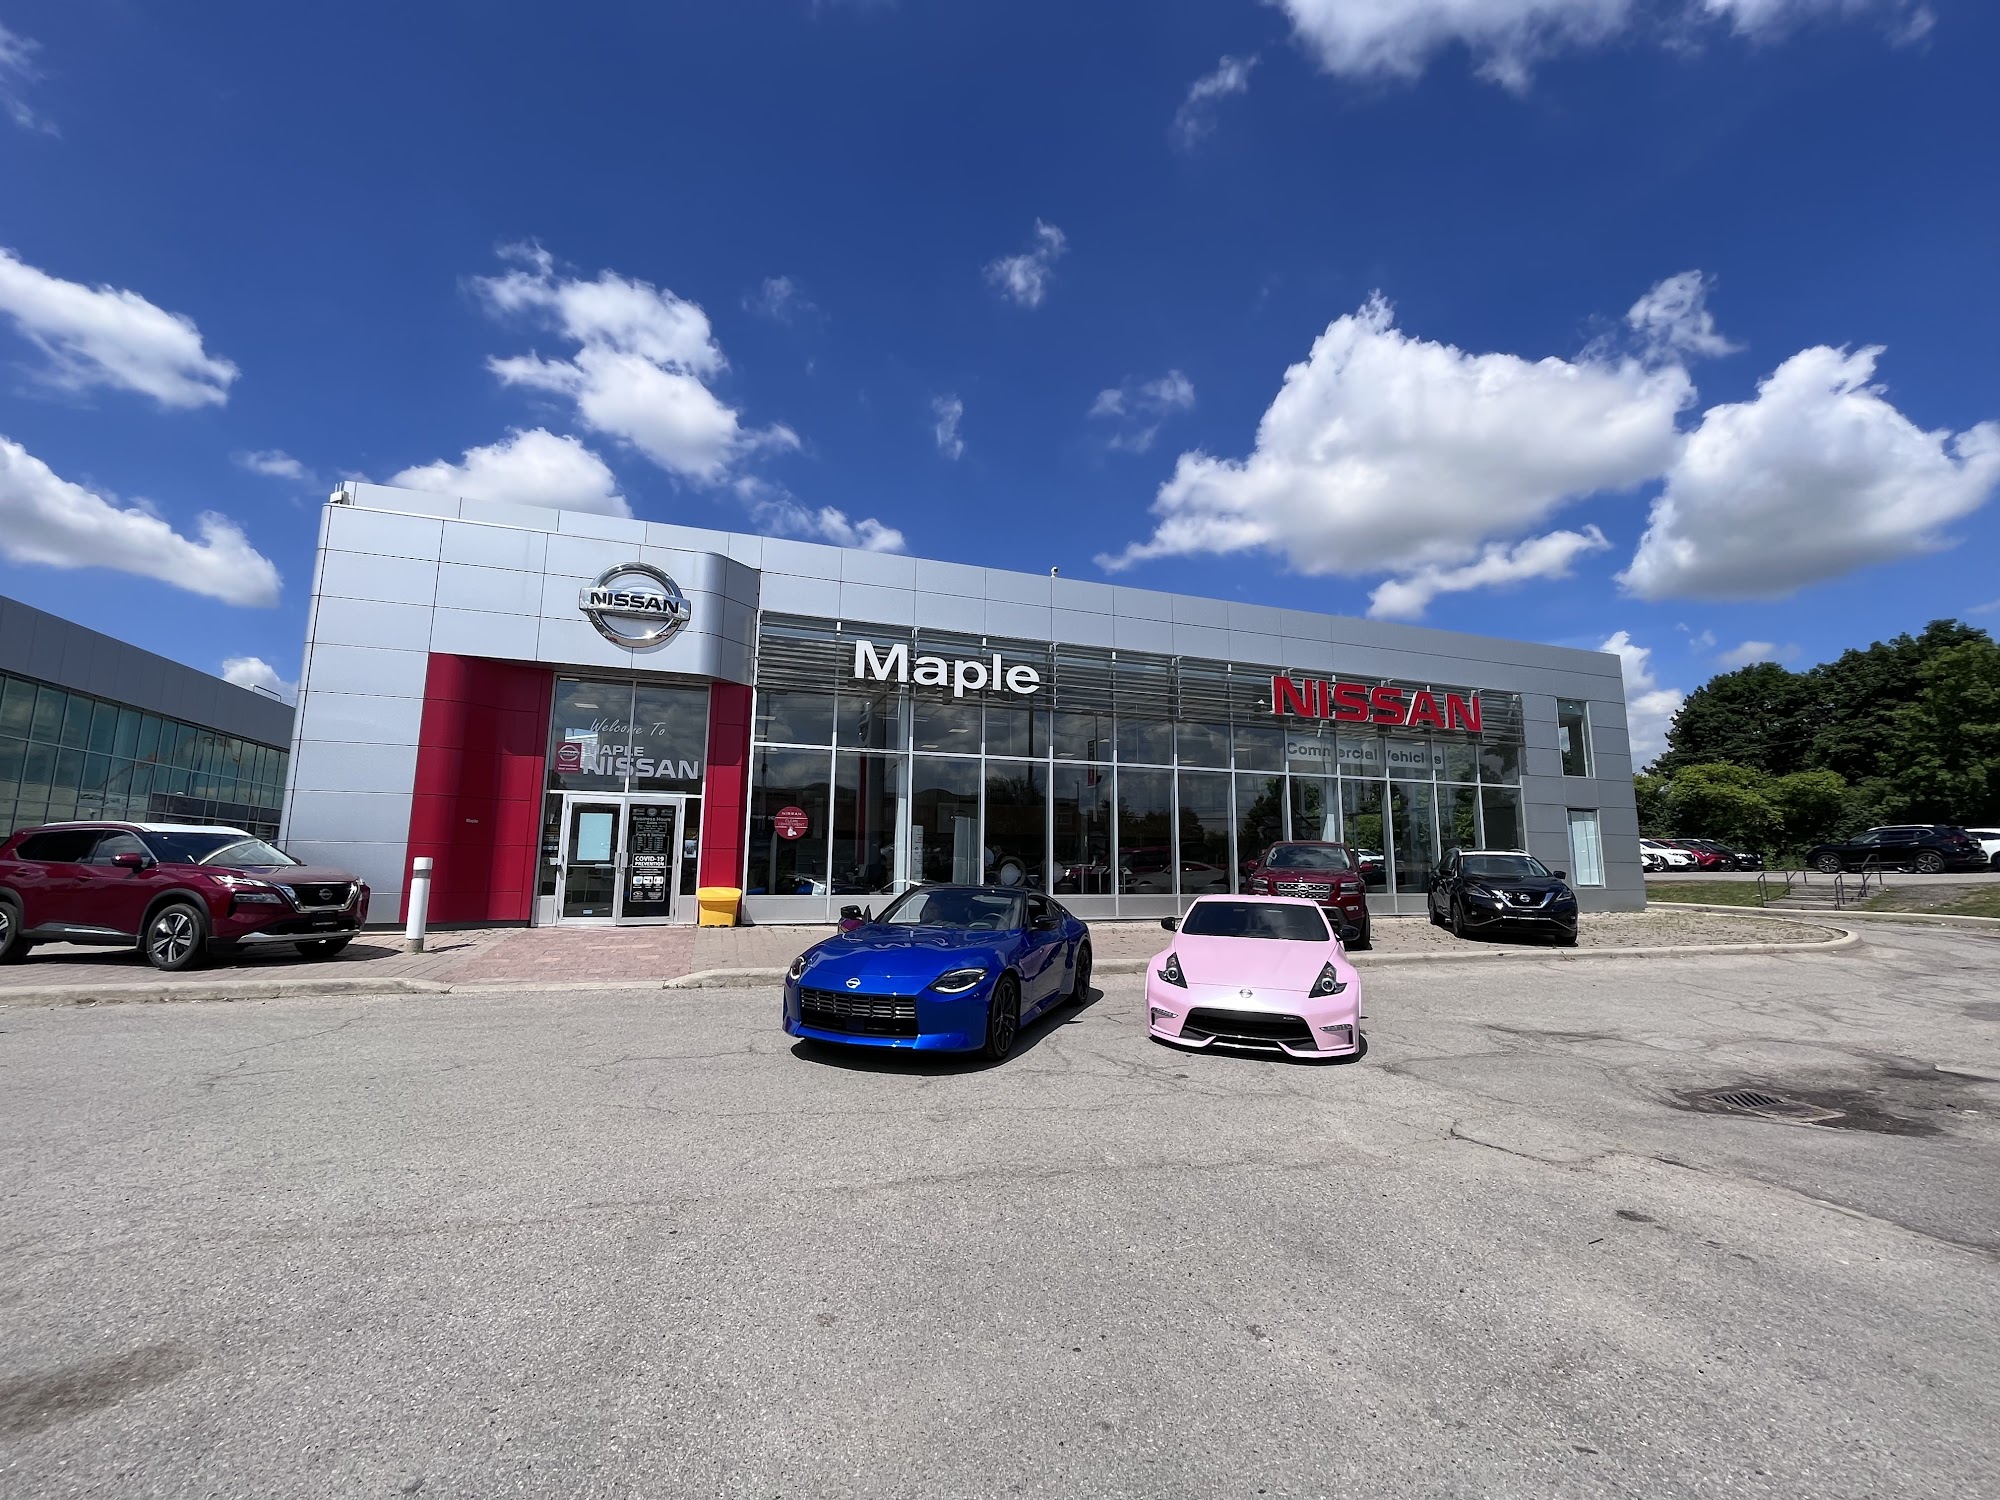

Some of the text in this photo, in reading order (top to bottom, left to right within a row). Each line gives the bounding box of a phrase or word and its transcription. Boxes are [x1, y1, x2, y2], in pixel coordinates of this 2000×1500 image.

[590, 592, 680, 614] NISSAN
[854, 639, 1040, 698] Maple
[1271, 675, 1483, 733] NISSAN
[650, 722, 666, 736] To
[583, 756, 699, 780] NISSAN
[1387, 749, 1442, 765] ehicls
